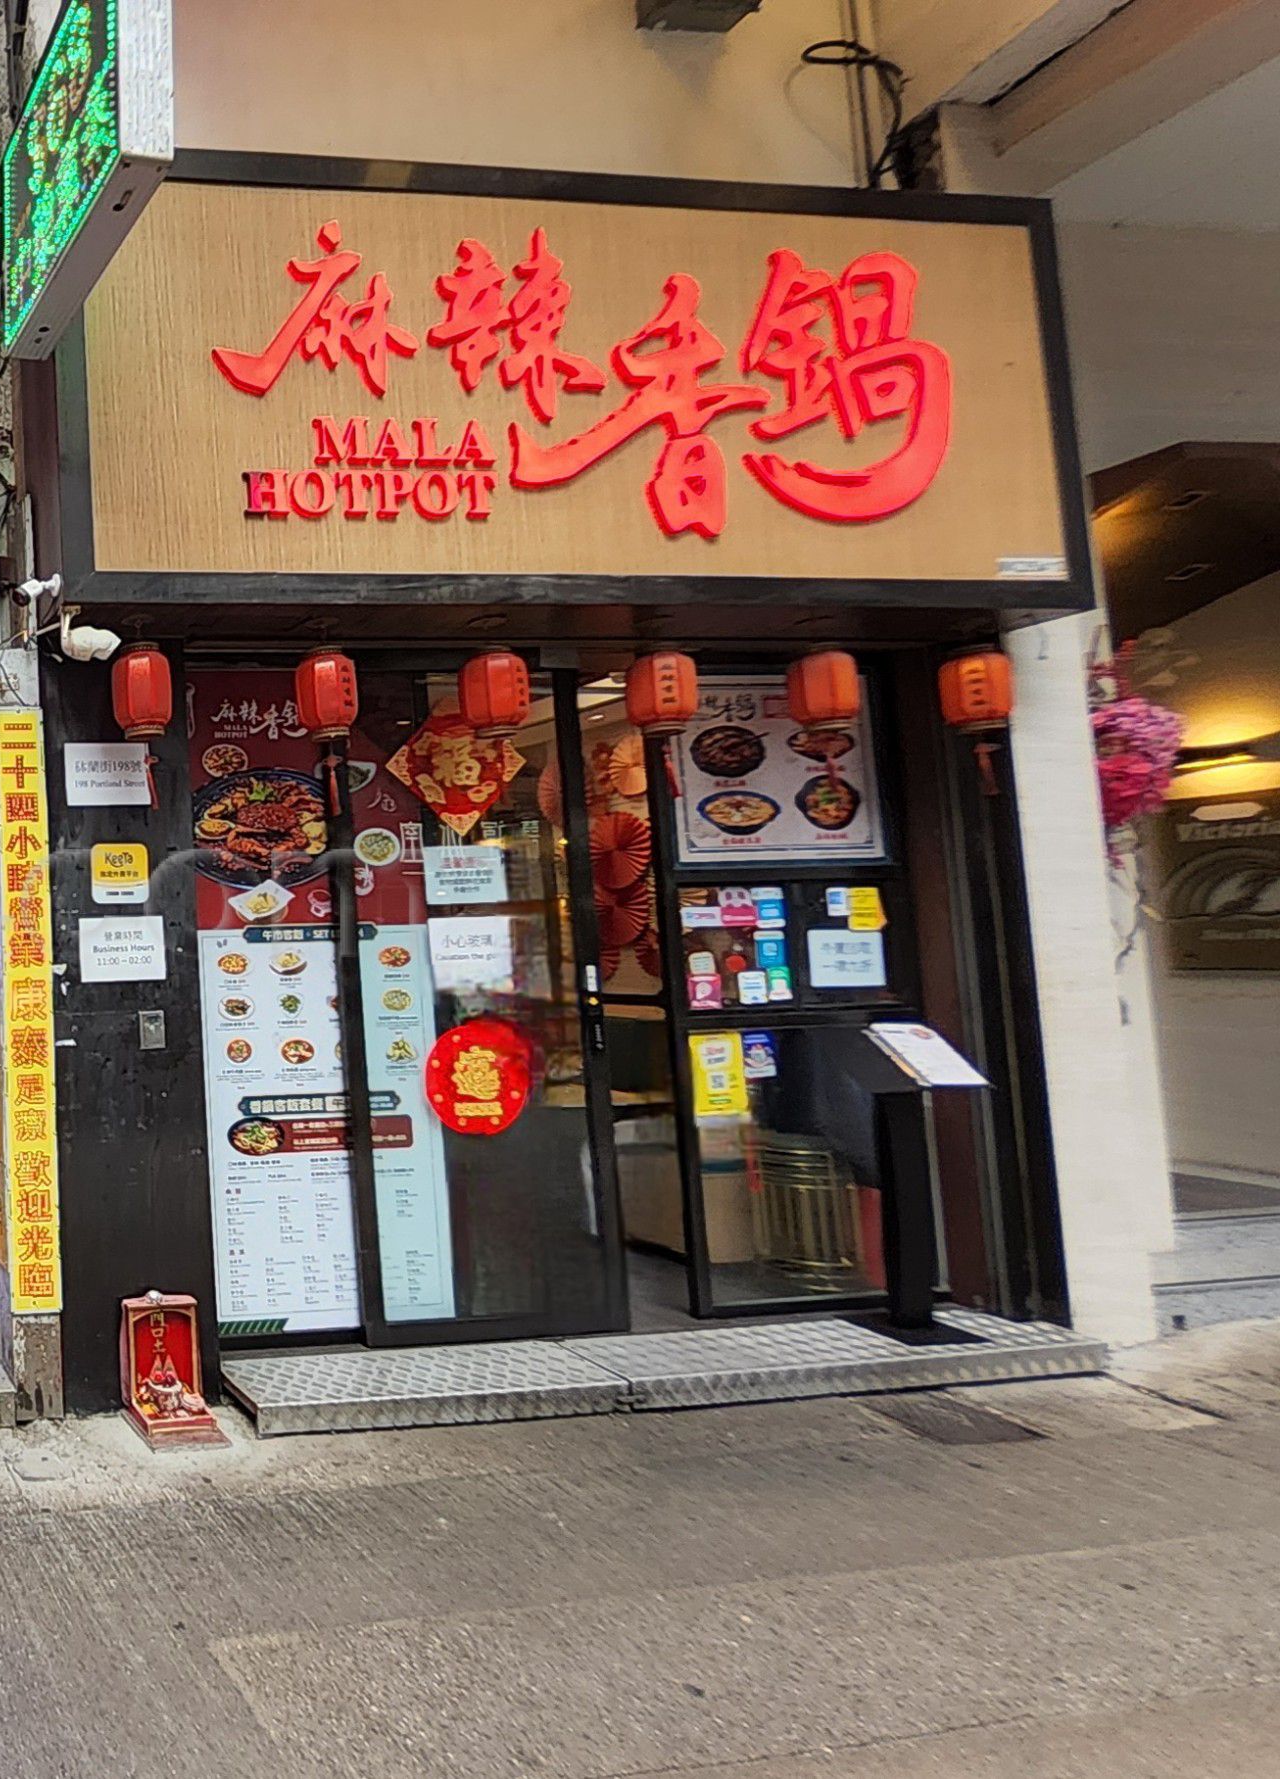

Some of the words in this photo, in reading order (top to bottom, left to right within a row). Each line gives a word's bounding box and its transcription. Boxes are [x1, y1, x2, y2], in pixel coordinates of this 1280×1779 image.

[211, 217, 953, 540] 麻辣香鍋
[311, 415, 497, 470] MALA
[241, 469, 500, 521] HOTPOT
[90, 779, 122, 789] Portland
[124, 778, 146, 788] Street
[104, 851, 134, 868] KeeTa
[92, 945, 129, 954] Business
[130, 944, 155, 953] Hours
[97, 956, 120, 966] 11:00
[128, 955, 152, 965] 02:00
